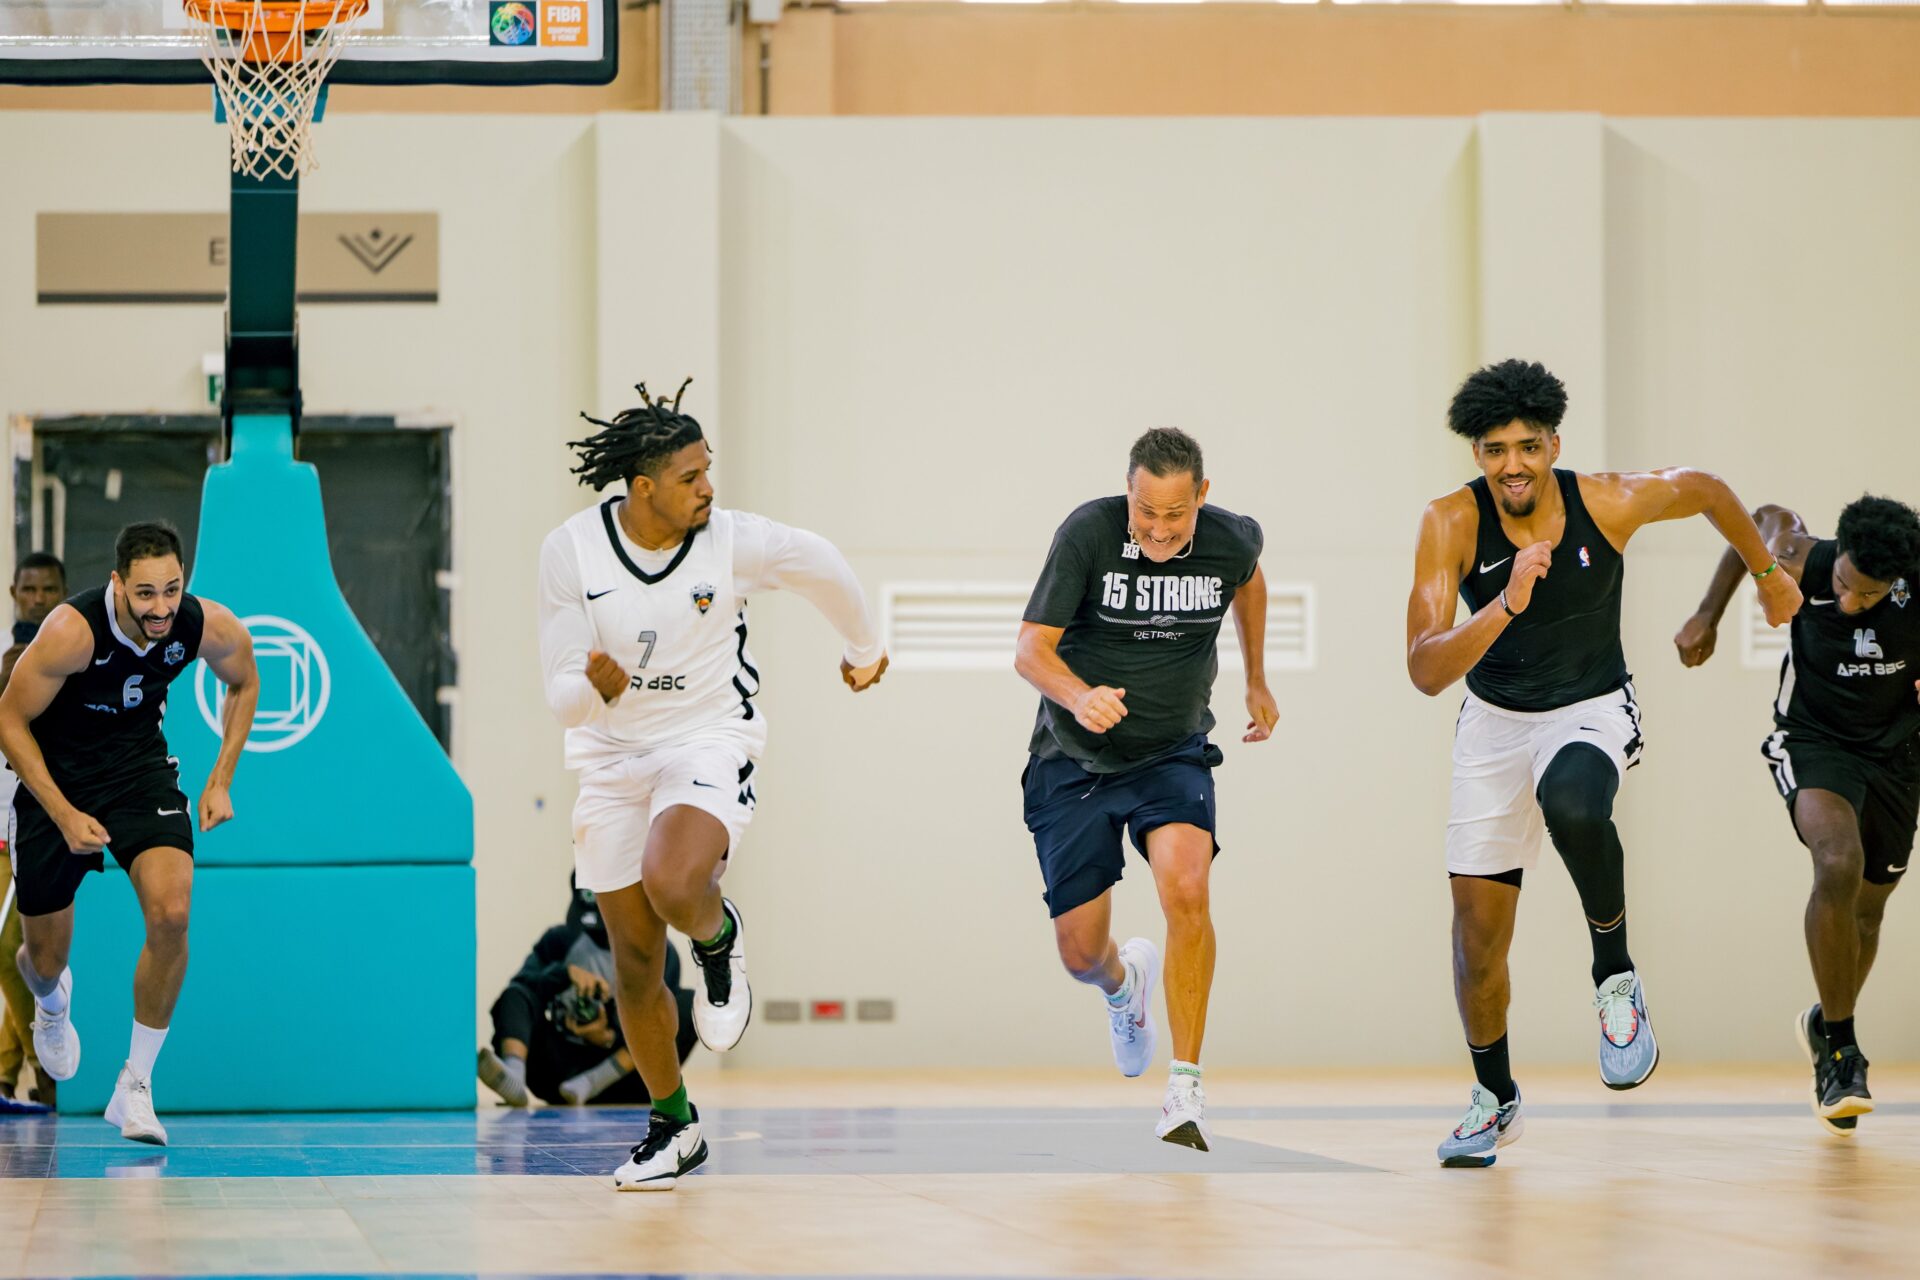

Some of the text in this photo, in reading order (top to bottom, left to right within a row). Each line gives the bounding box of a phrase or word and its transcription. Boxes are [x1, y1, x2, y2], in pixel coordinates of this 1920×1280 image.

[548, 6, 581, 22] FIBA
[1102, 572, 1223, 612] 15 STRONG
[637, 630, 657, 669] 7
[1853, 628, 1884, 659] 16
[1837, 660, 1906, 677] APR BBC
[123, 674, 144, 709] 6
